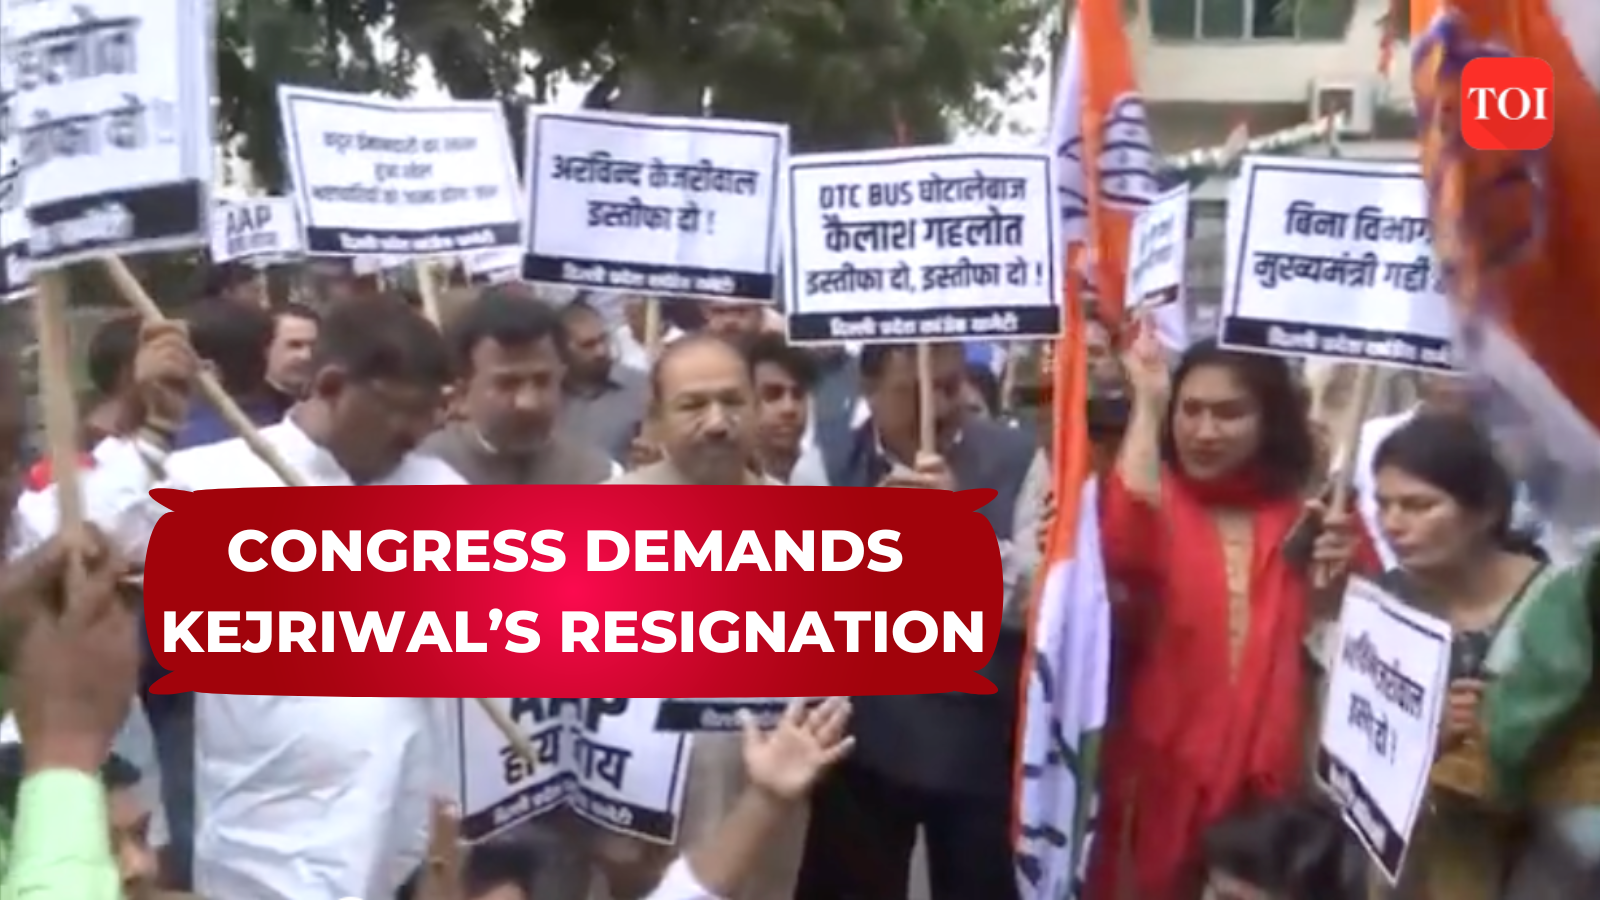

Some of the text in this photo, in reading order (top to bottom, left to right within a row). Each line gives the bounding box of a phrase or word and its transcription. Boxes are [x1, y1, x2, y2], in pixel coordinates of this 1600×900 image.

[552, 151, 760, 195] अरविन्द केजरीवाल
[819, 170, 1027, 210] DTC BUS घोटालेबाज
[227, 205, 272, 237] AAP
[586, 196, 716, 235] इस्तीफा दो !
[822, 206, 1025, 251] कैलाश गहलोत
[1285, 200, 1349, 239] बिना
[806, 257, 1043, 296] इस्तीफा दो, इस्तीफा दो !
[1253, 252, 1379, 289] मुख्यमंत्री
